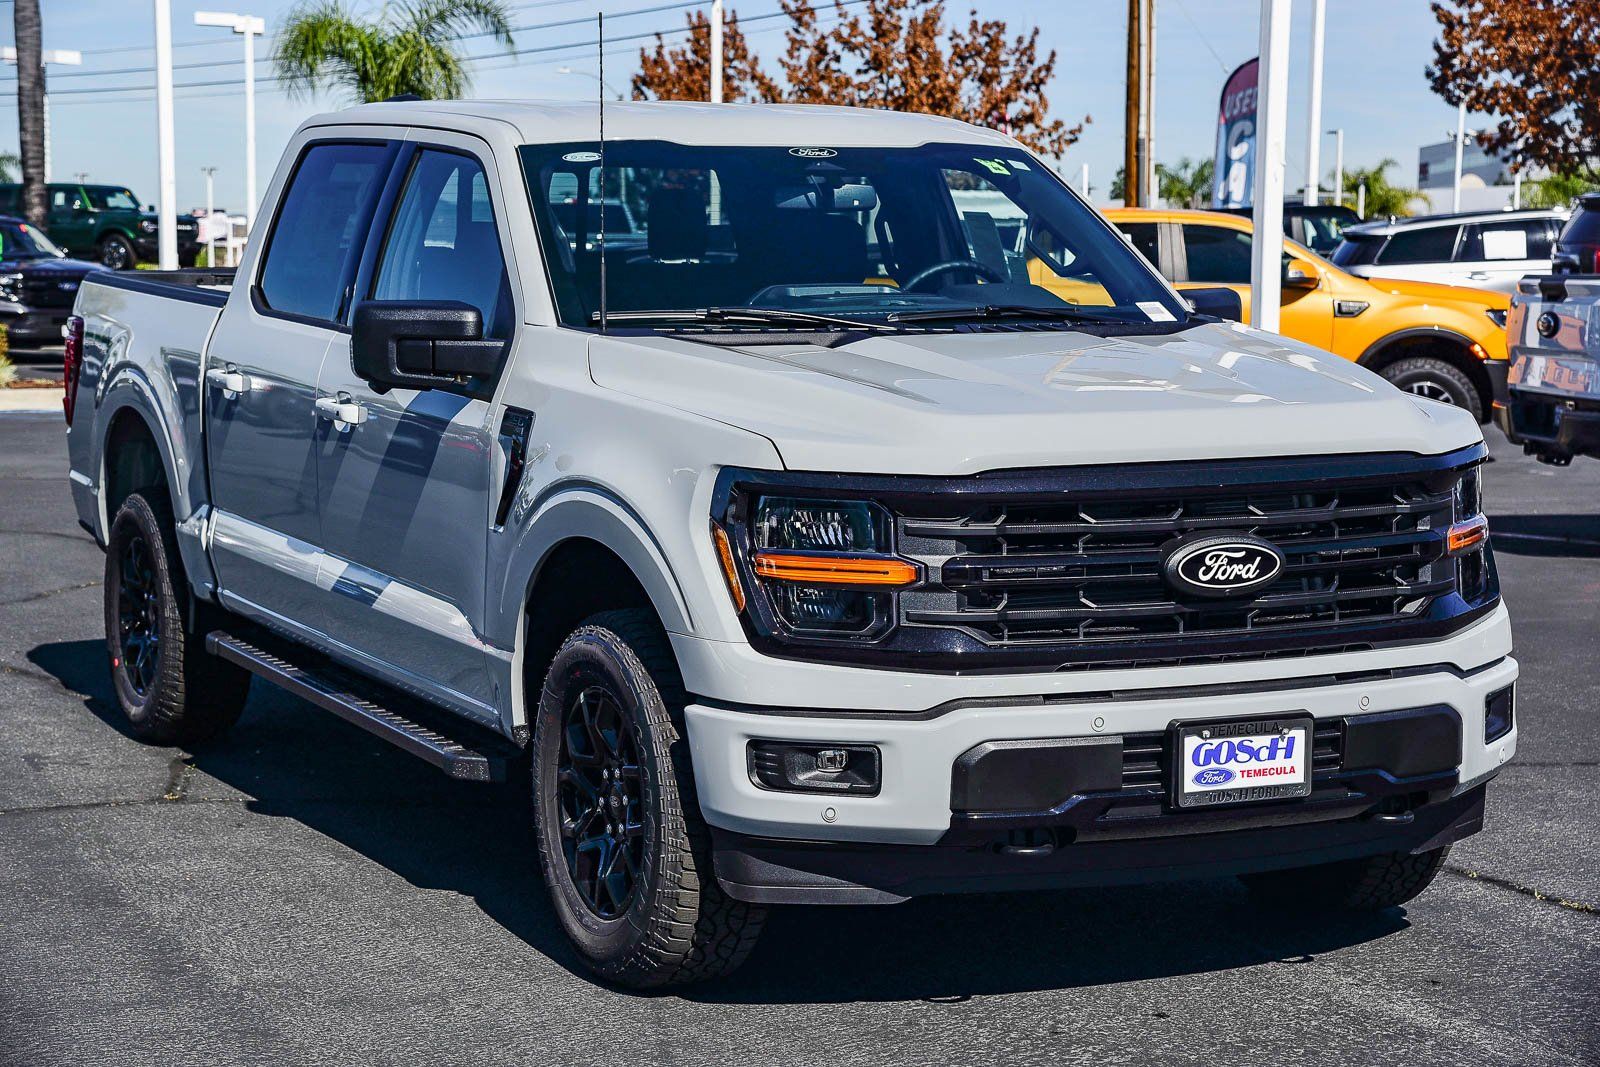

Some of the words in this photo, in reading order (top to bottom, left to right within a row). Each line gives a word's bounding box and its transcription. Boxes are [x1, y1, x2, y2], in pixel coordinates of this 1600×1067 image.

[799, 148, 829, 156] Ford
[1199, 550, 1261, 581] Ford
[1210, 721, 1280, 738] TEMECULA
[1201, 770, 1225, 784] Ford
[1240, 766, 1296, 778] TEMECULA
[1251, 786, 1280, 800] FORD
